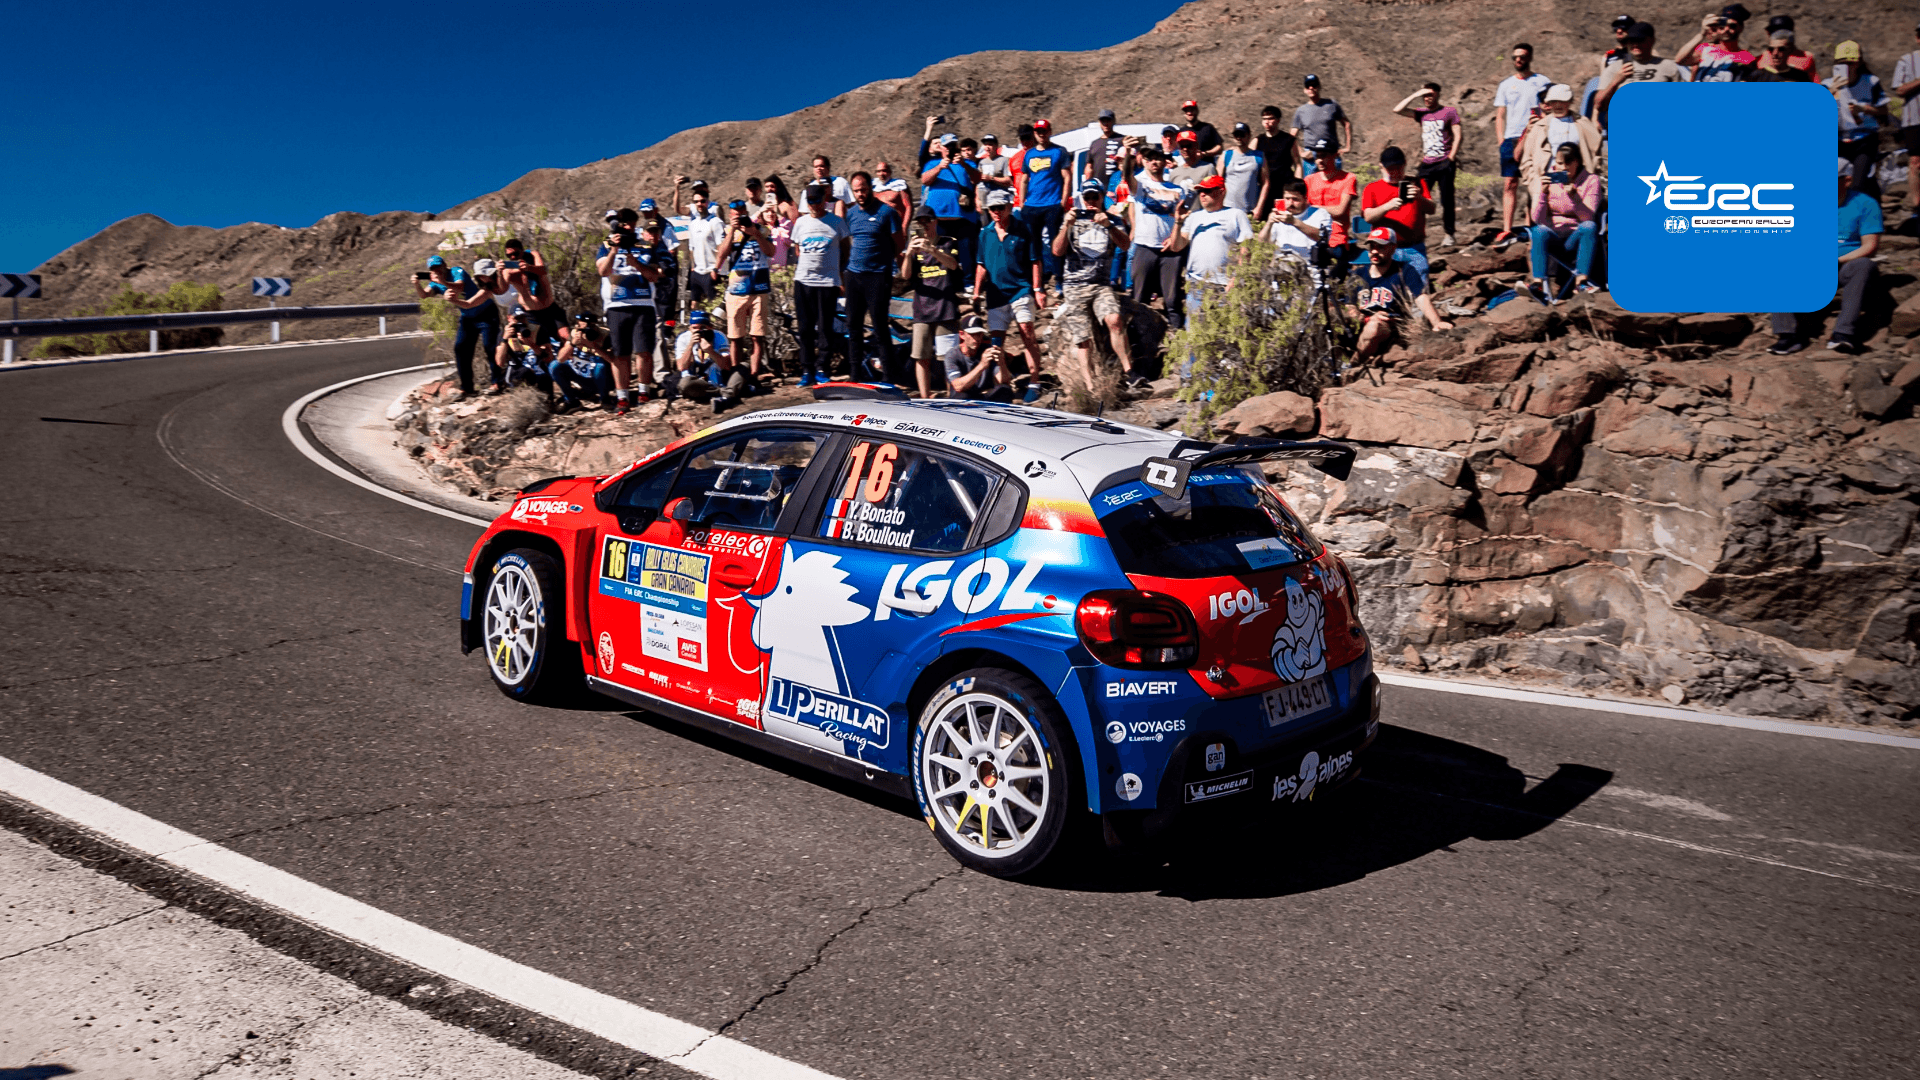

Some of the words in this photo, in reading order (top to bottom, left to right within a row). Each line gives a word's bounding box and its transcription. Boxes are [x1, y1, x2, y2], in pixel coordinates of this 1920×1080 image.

[742, 411, 834, 421] boutique.citroenracing.com
[864, 416, 888, 426] alpes
[952, 435, 992, 451] E.Leclerc
[843, 442, 899, 504] 16
[529, 501, 569, 514] VOYAGES
[849, 500, 860, 520] Y.
[861, 502, 906, 526] Bonato
[842, 521, 855, 540] B.
[856, 523, 915, 548] Boulloud
[608, 540, 627, 579] 16
[650, 573, 668, 590] GRAN
[668, 574, 696, 597] CANARIA
[624, 586, 634, 596] FIA
[644, 592, 680, 608] Championship
[681, 642, 697, 654] AVIS
[820, 720, 867, 751] Racing
[1128, 719, 1186, 734] VOYAGES
[912, 733, 926, 804] MICHELIN
[1207, 751, 1224, 765] gan
[1206, 778, 1249, 794] MICHELIN
[1271, 774, 1298, 802] les
[1317, 749, 1354, 784] alpes
